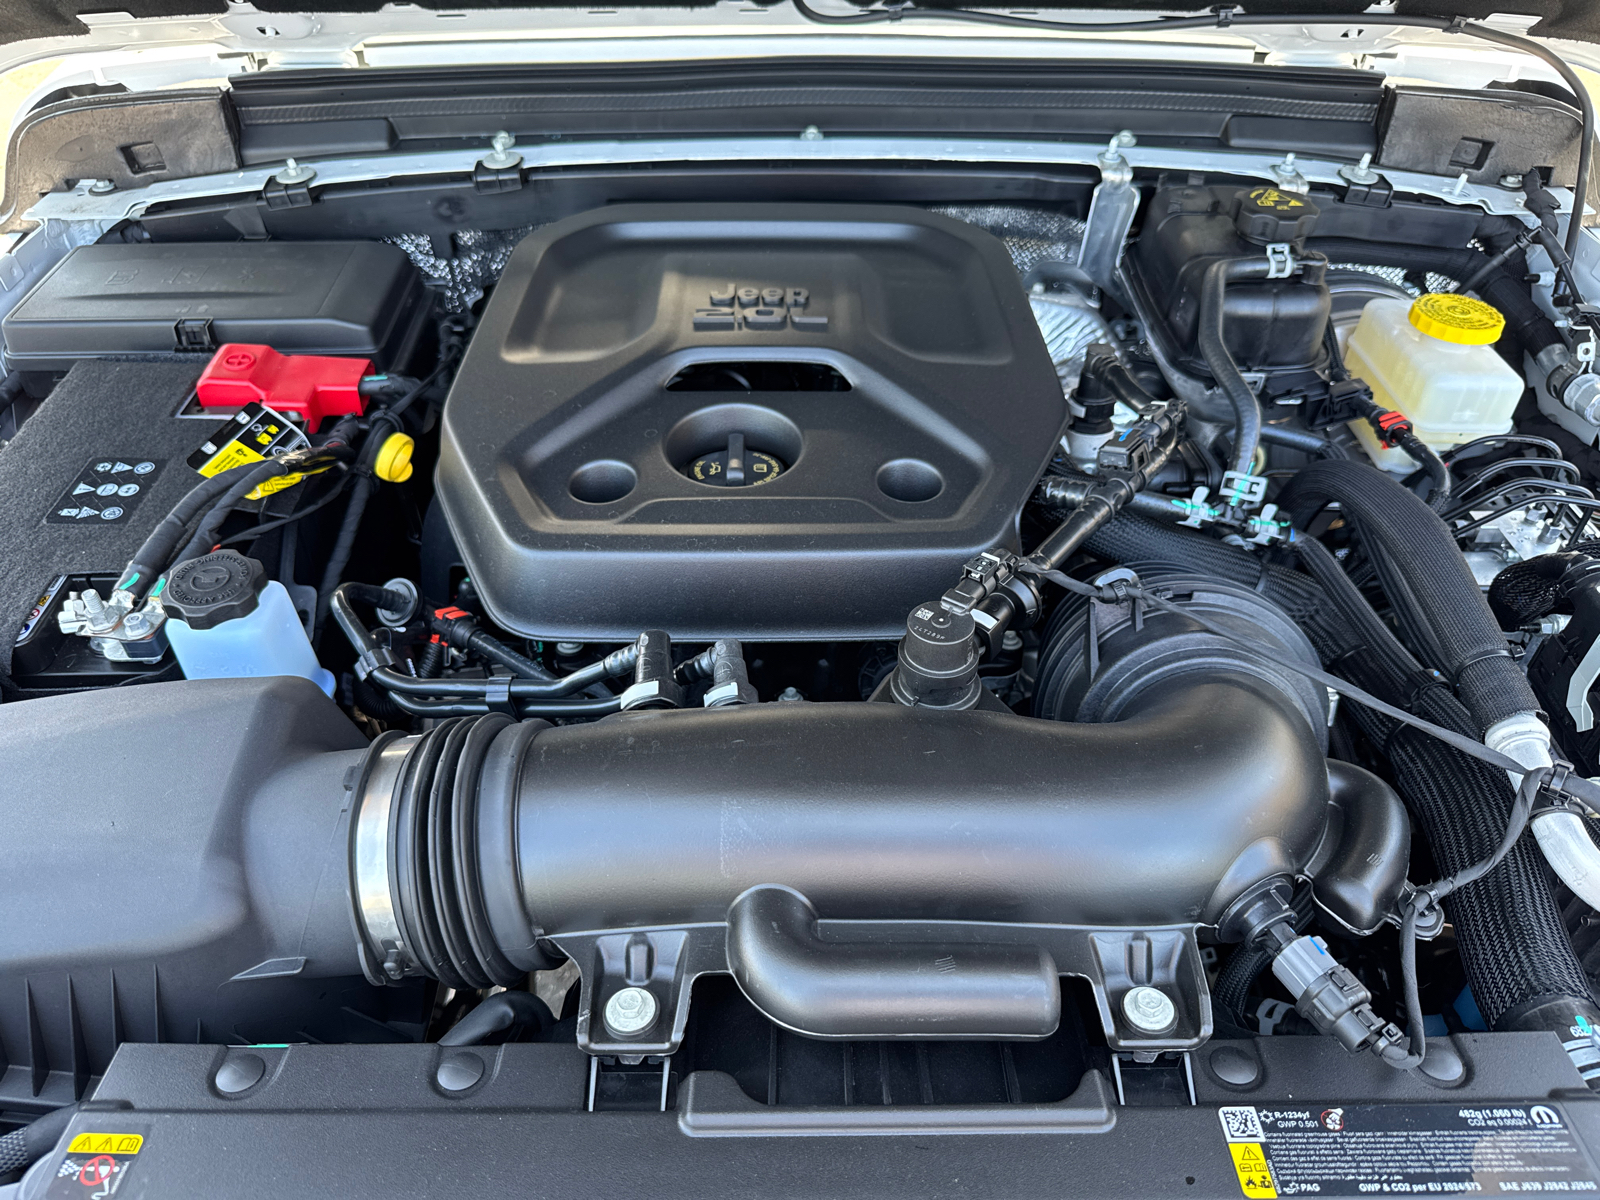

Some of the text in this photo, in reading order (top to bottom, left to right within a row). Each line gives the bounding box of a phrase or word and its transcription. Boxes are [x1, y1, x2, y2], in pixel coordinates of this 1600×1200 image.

[709, 283, 810, 307] Jeep
[692, 306, 829, 329] 2.0L
[196, 554, 238, 565] STEERING
[175, 563, 195, 580] FLUID
[173, 589, 215, 604] APPROVED
[1277, 1120, 1319, 1129] GWP 0.501
[1467, 1118, 1486, 1127] CO2
[1300, 1182, 1321, 1192] PAG
[1358, 1182, 1380, 1192] GWP
[1382, 1182, 1391, 1192] &
[1391, 1182, 1411, 1192] CO2
[1412, 1183, 1427, 1193] per
[1427, 1181, 1442, 1192] EU
[1499, 1181, 1520, 1191] SAE
